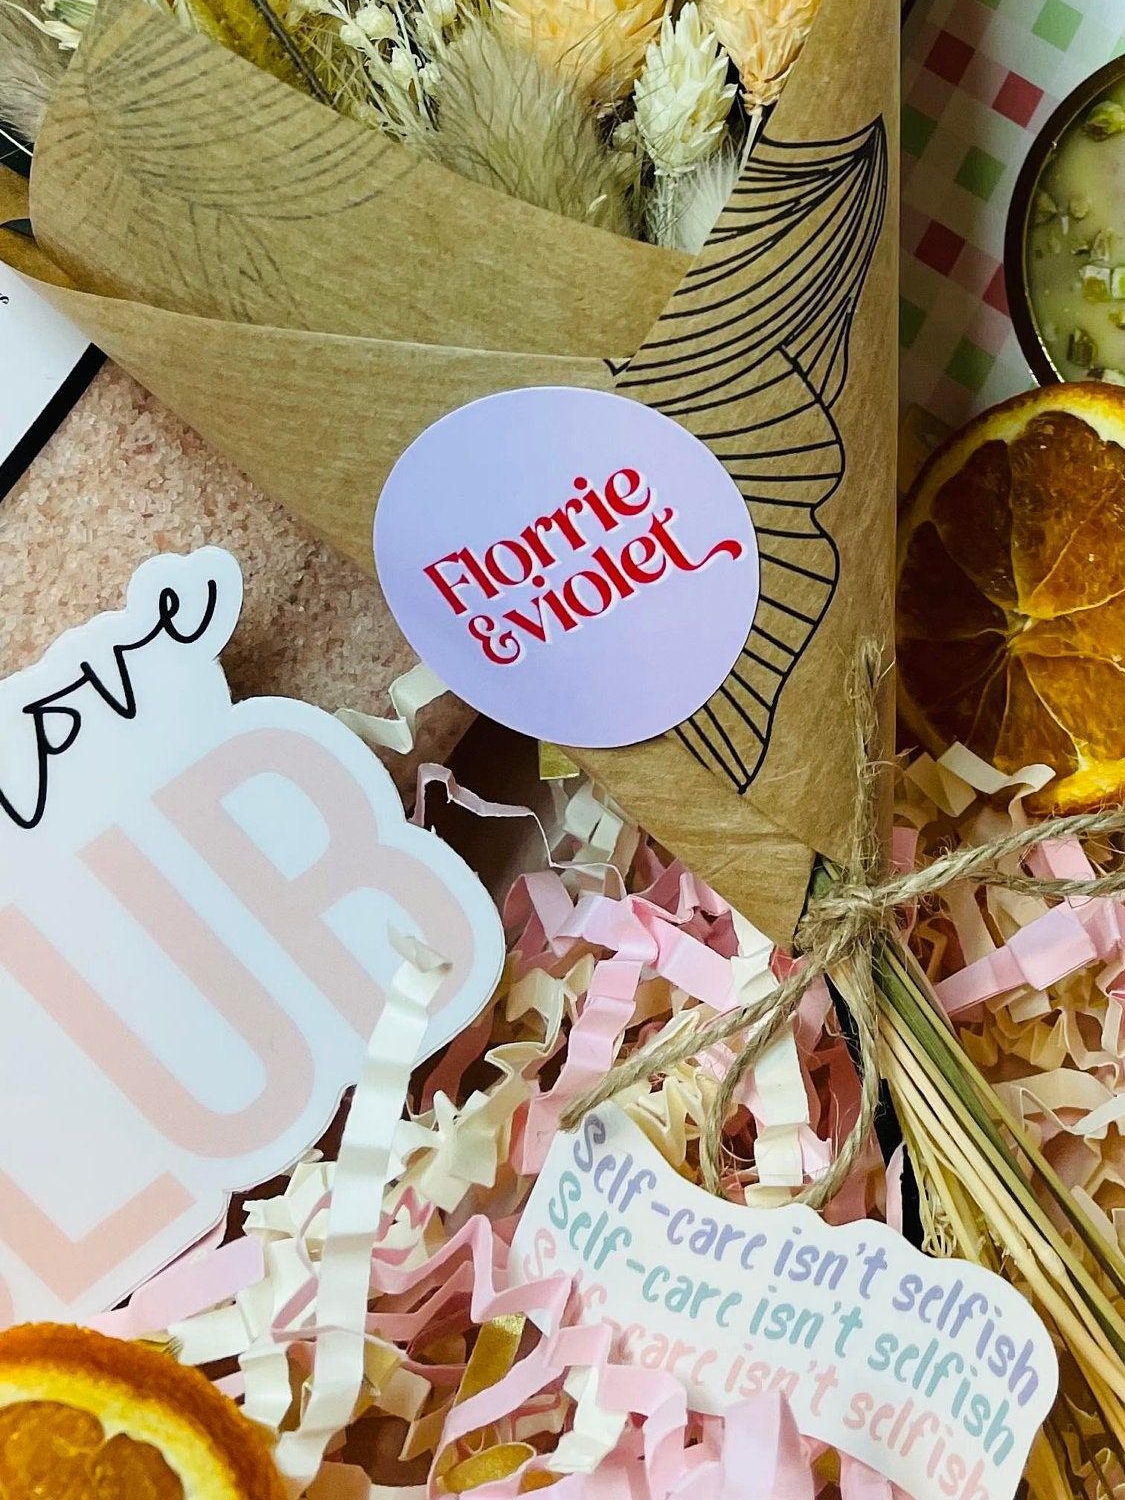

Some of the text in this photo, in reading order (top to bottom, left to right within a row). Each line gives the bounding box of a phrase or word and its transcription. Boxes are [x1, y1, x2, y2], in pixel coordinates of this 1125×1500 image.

[423, 467, 651, 616] Florrie
[0, 578, 218, 829] ove
[749, 1285, 863, 1359] isn't
[867, 1333, 1015, 1467] selfish
[773, 1226, 888, 1299] isn't
[892, 1274, 1039, 1407] selfish
